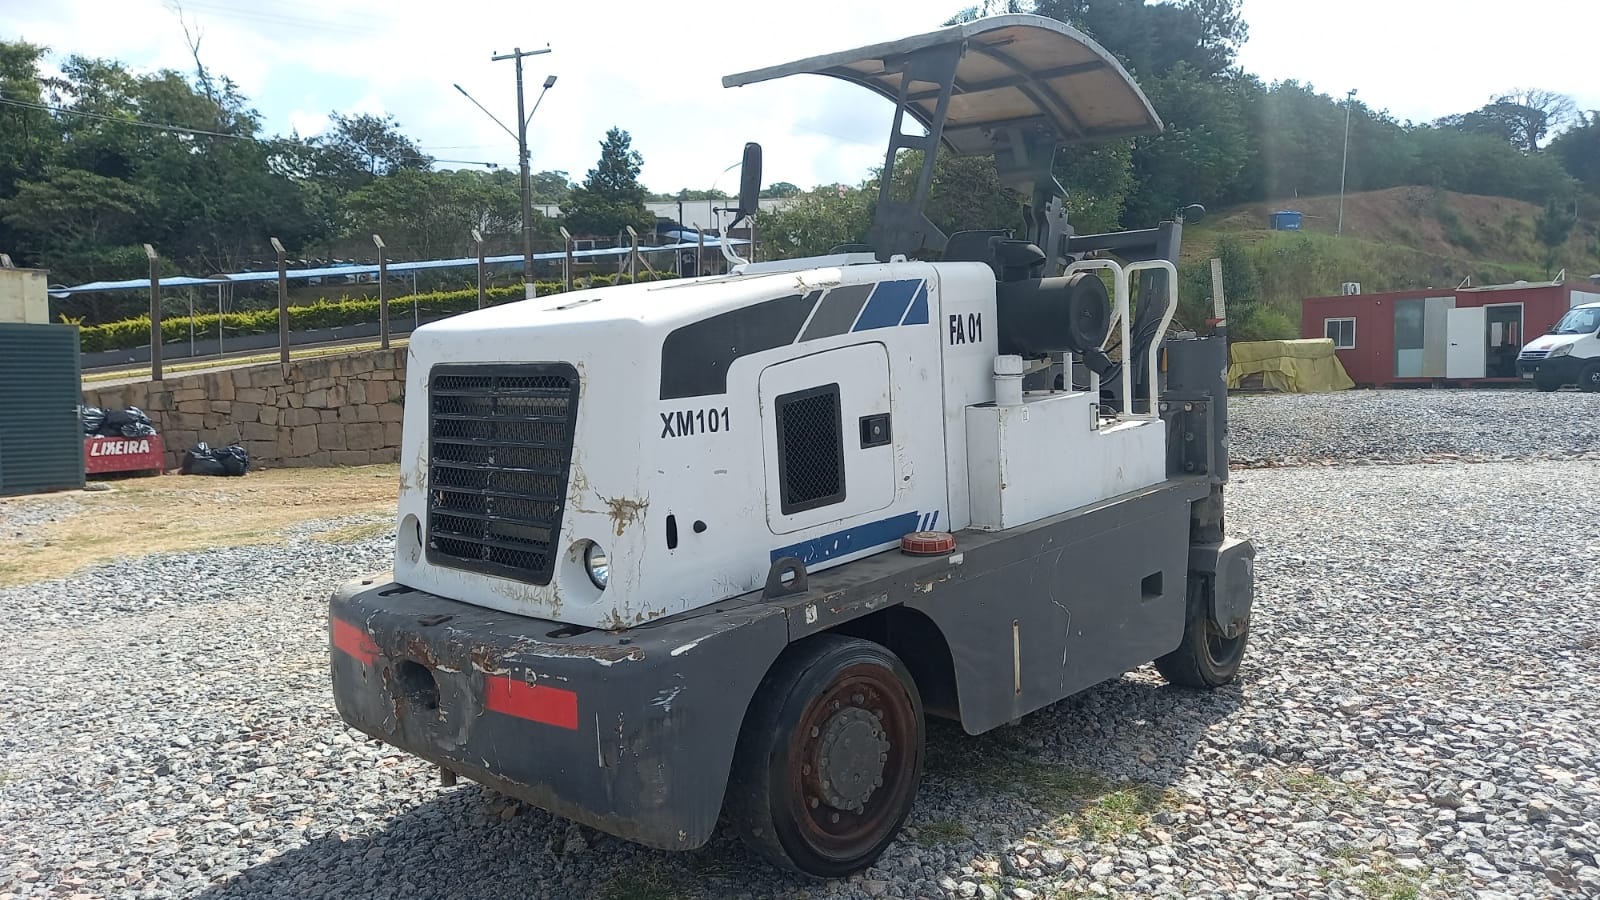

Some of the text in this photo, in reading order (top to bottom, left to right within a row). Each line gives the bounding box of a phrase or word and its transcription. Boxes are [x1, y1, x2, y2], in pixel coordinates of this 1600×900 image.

[949, 312, 982, 345] FA 01
[660, 406, 730, 439] XM101
[90, 439, 150, 457] LIXEIRA
